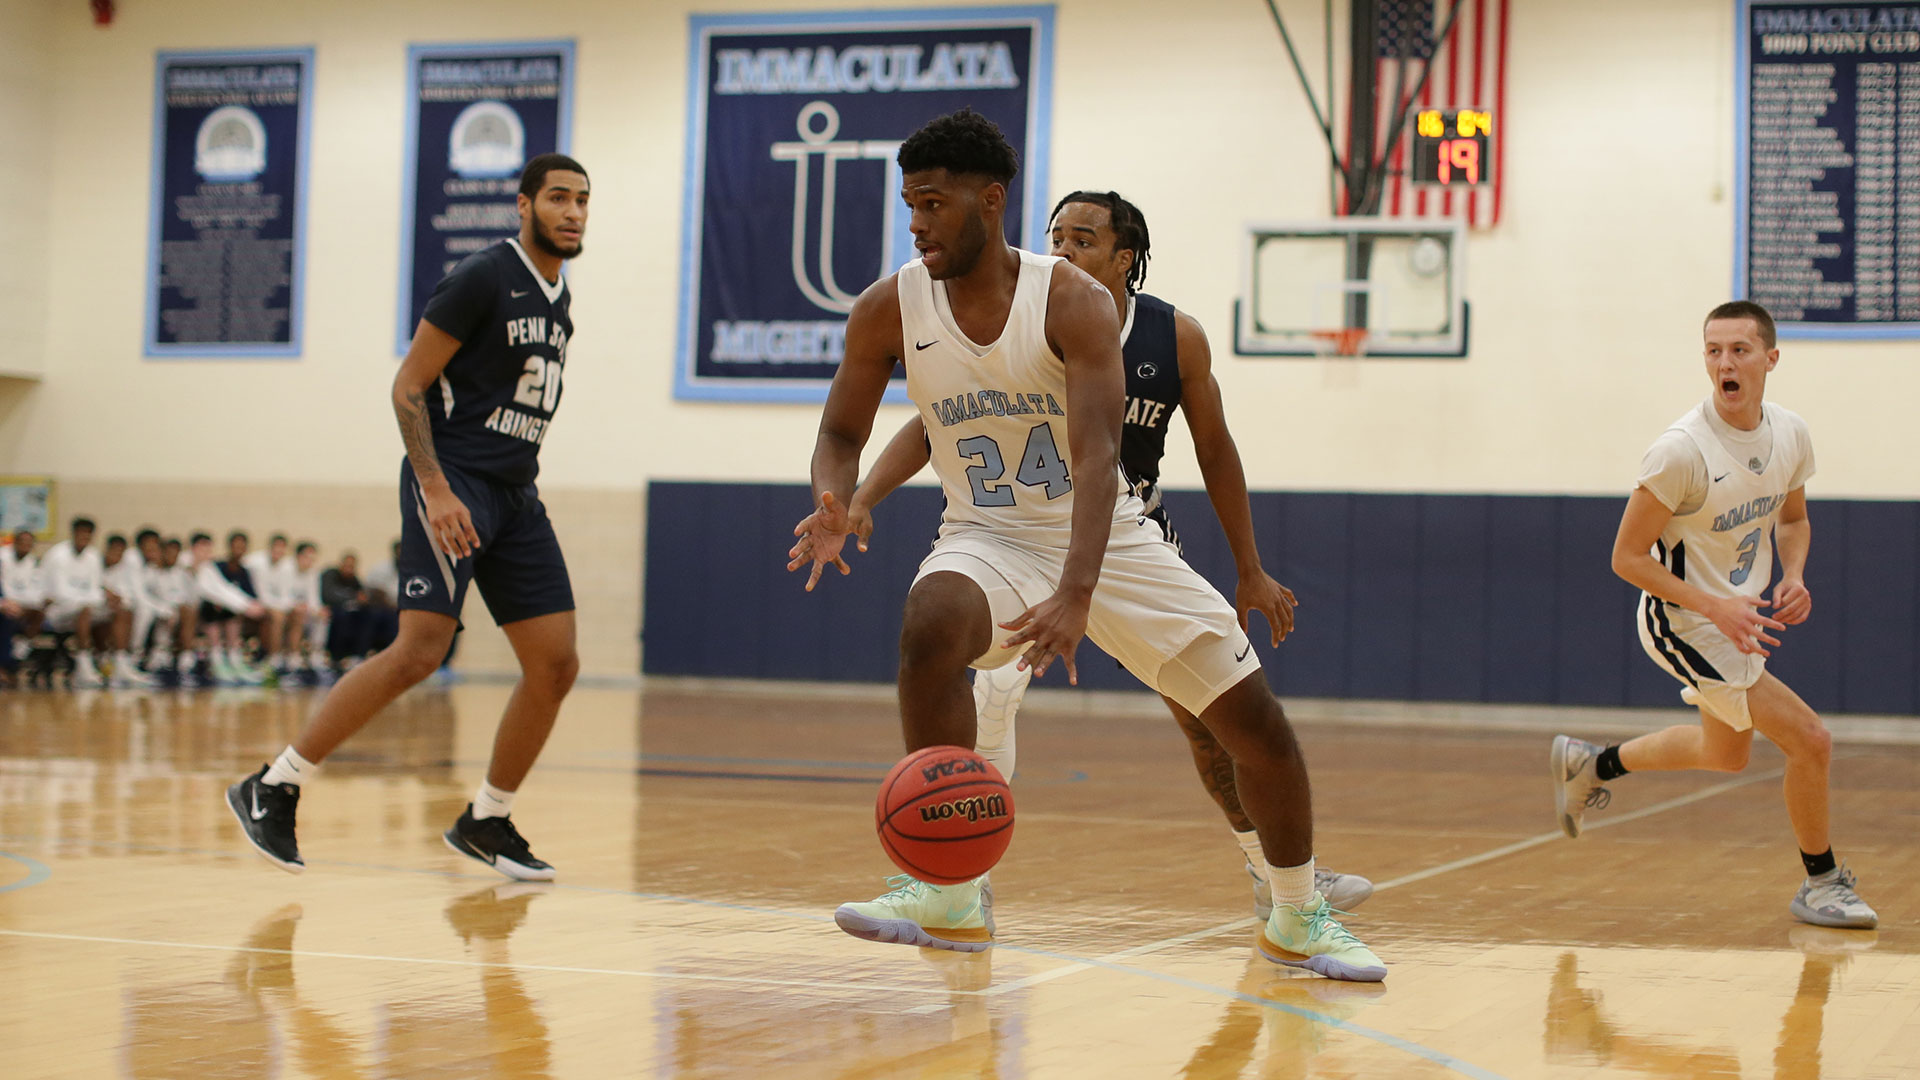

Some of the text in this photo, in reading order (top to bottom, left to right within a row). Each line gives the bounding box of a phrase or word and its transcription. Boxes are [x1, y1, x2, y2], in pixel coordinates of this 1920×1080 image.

[1810, 32, 1867, 54] POINT
[1869, 31, 1920, 53] CLUB
[715, 43, 1019, 94] IMMACULATA
[1438, 138, 1479, 185] 19
[507, 316, 546, 346] PENN
[513, 353, 562, 413] 20
[931, 389, 1065, 427] IMMACULATA
[1125, 395, 1166, 428] ATE
[956, 421, 1072, 506] 24
[1729, 527, 1761, 586] 3
[922, 759, 986, 782] NCAA
[920, 793, 1008, 823] Wilson
